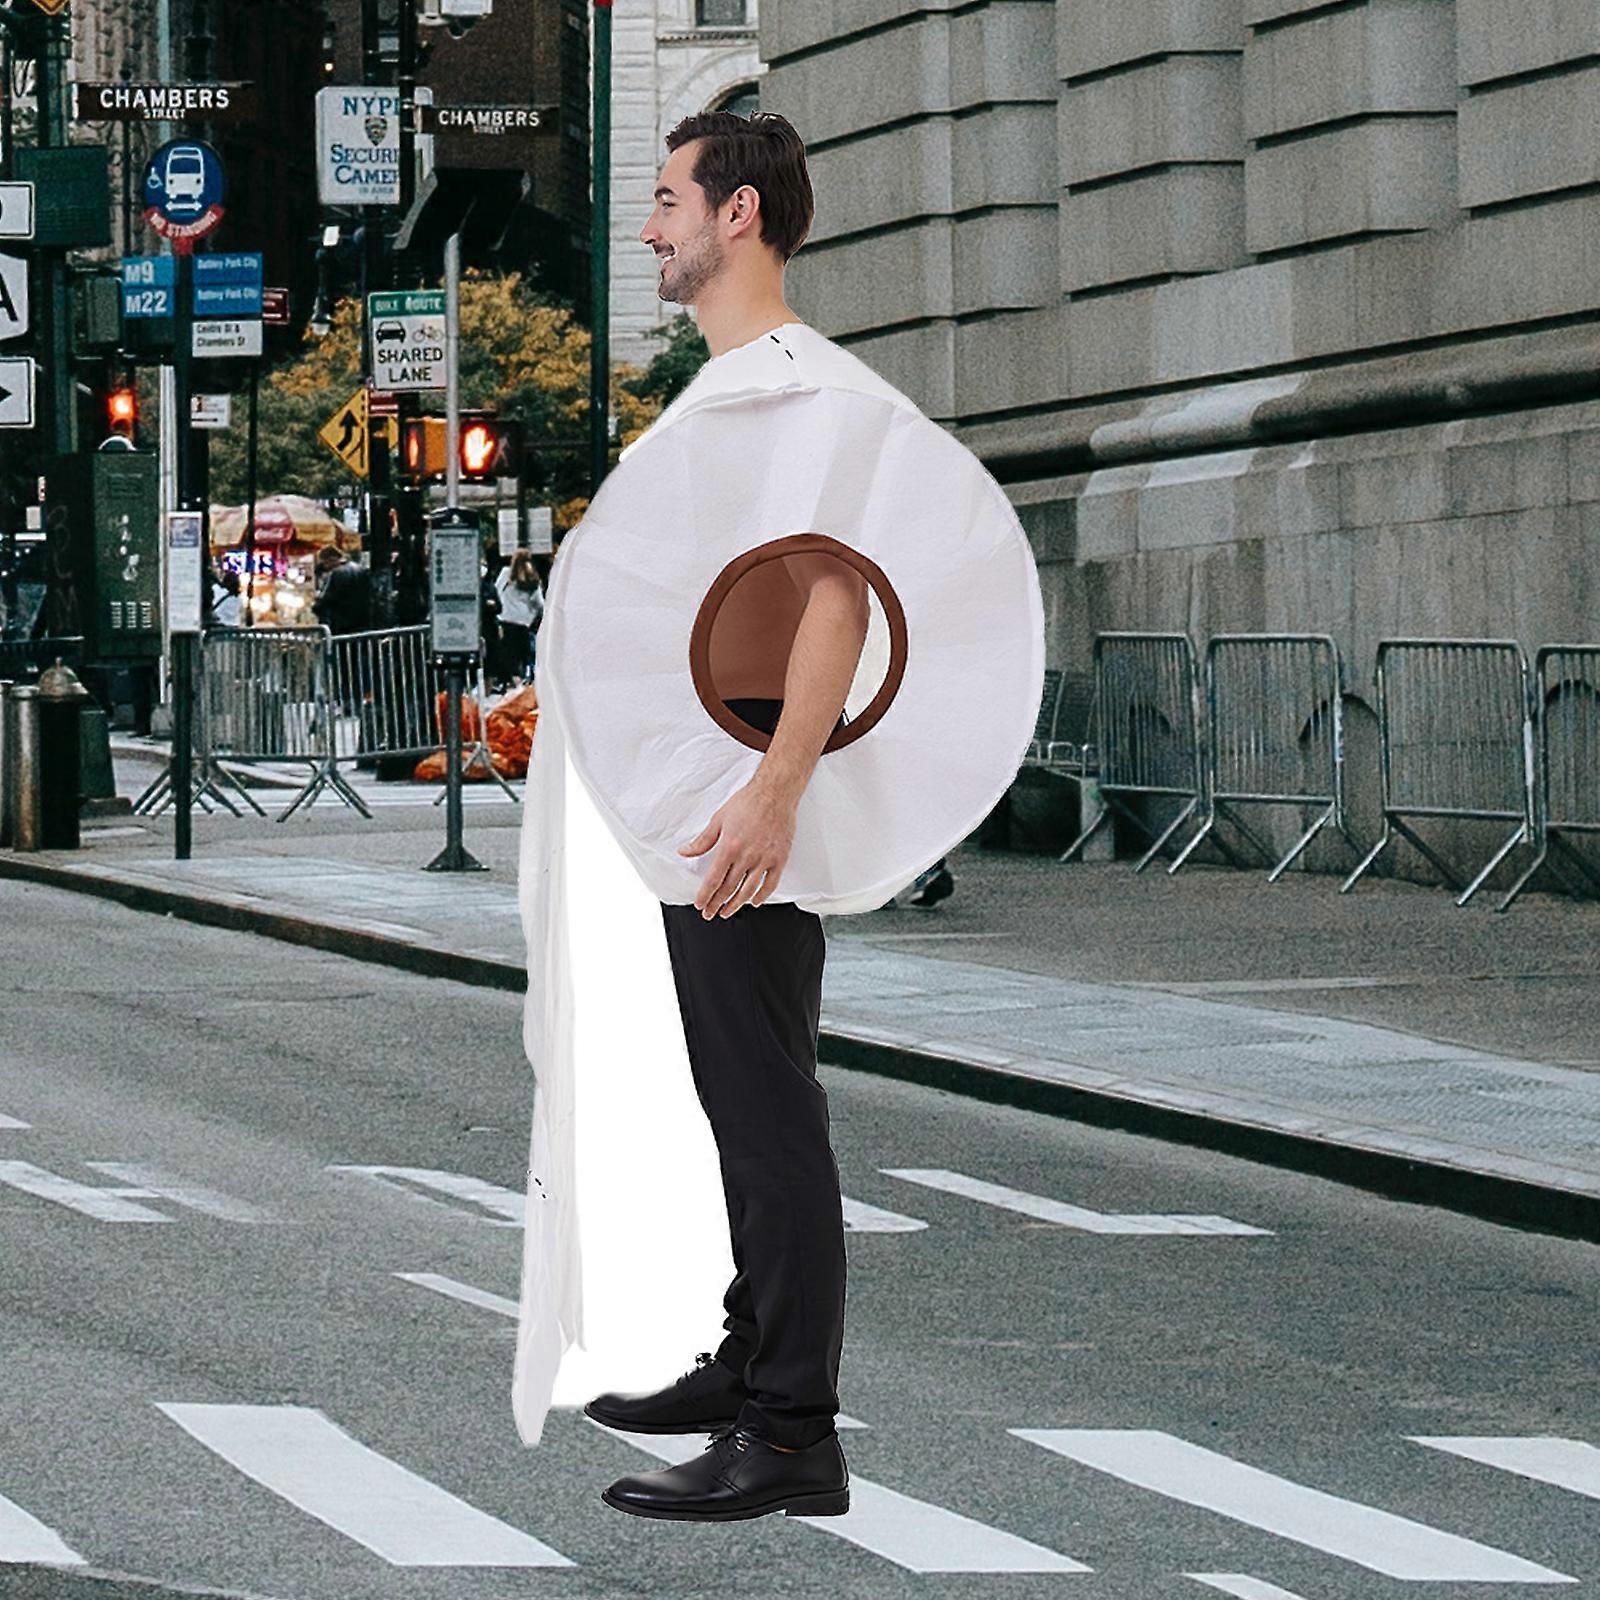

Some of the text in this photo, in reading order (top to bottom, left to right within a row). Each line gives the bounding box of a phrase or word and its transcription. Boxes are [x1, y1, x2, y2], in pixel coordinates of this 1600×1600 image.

[100, 88, 230, 109] CHAMBERS
[143, 108, 186, 120] STREET
[438, 109, 540, 127] CHAMBERS
[330, 143, 400, 164] SECURI
[125, 260, 155, 284] M9
[126, 290, 168, 313] M22
[405, 296, 442, 313] ROUTE
[377, 346, 444, 364] SHARED
[388, 366, 432, 383] LANE
